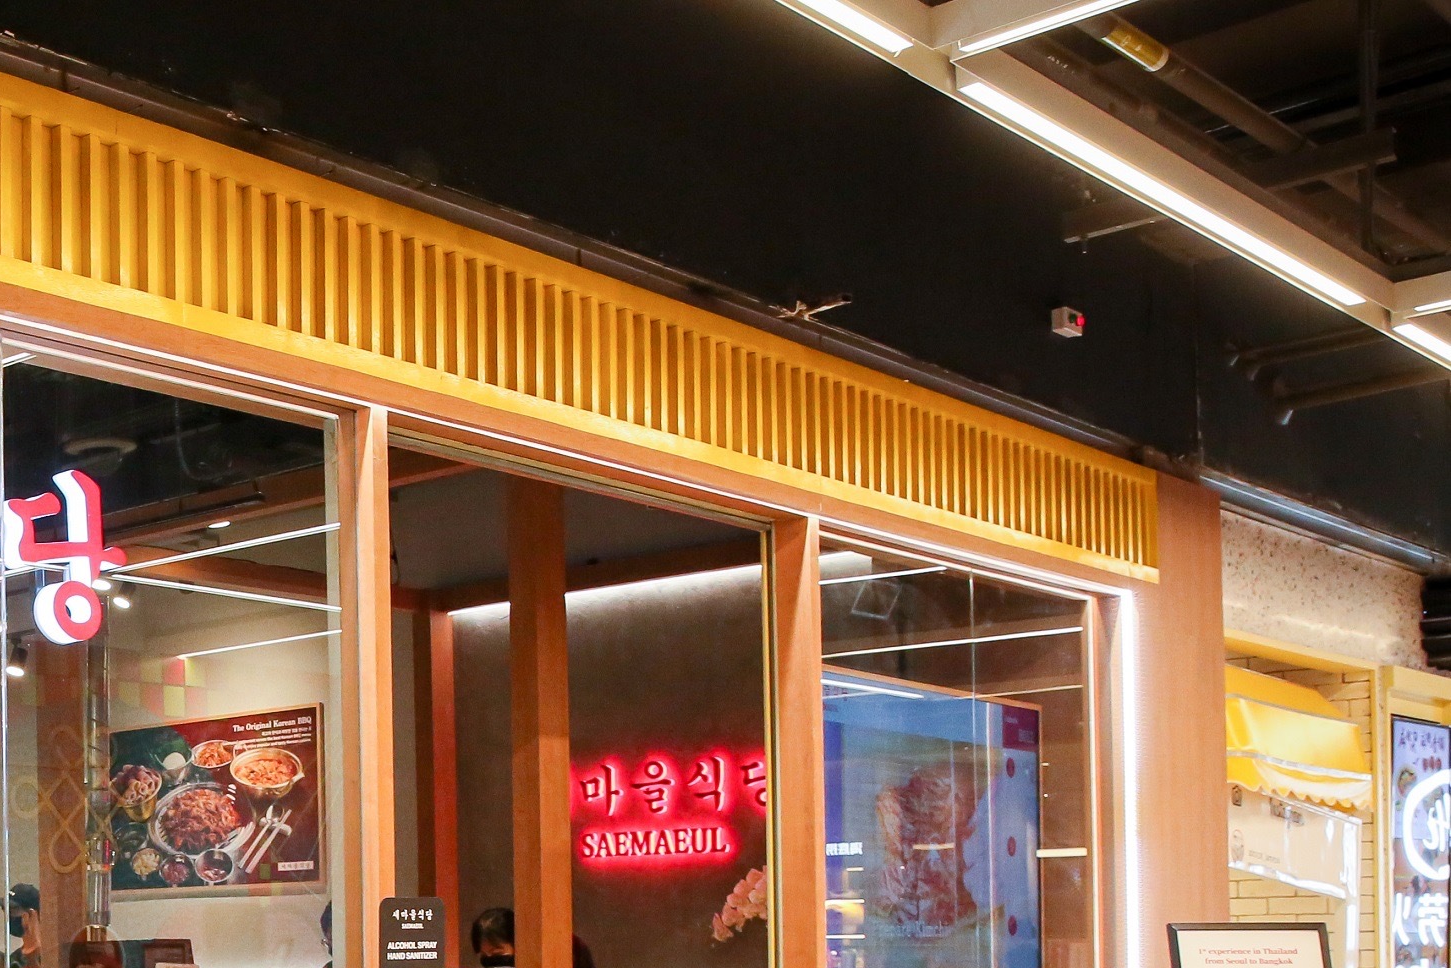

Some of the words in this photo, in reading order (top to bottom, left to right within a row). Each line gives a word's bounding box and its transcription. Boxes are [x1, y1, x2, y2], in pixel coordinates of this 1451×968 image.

[246, 720, 271, 731] Original
[273, 719, 296, 727] Korean
[298, 716, 312, 724] BBQ
[582, 826, 730, 859] SAEMAEUL
[392, 908, 433, 921] 새마을식당
[387, 941, 417, 950] ALCOHOL
[417, 941, 438, 949] SPRAY
[387, 952, 405, 960] HAND
[406, 951, 438, 960] SANITIZER
[1208, 948, 1251, 958] experience
[1205, 957, 1224, 965] from
[1226, 957, 1247, 965] Seoul
[1259, 957, 1293, 966] Bangkok
